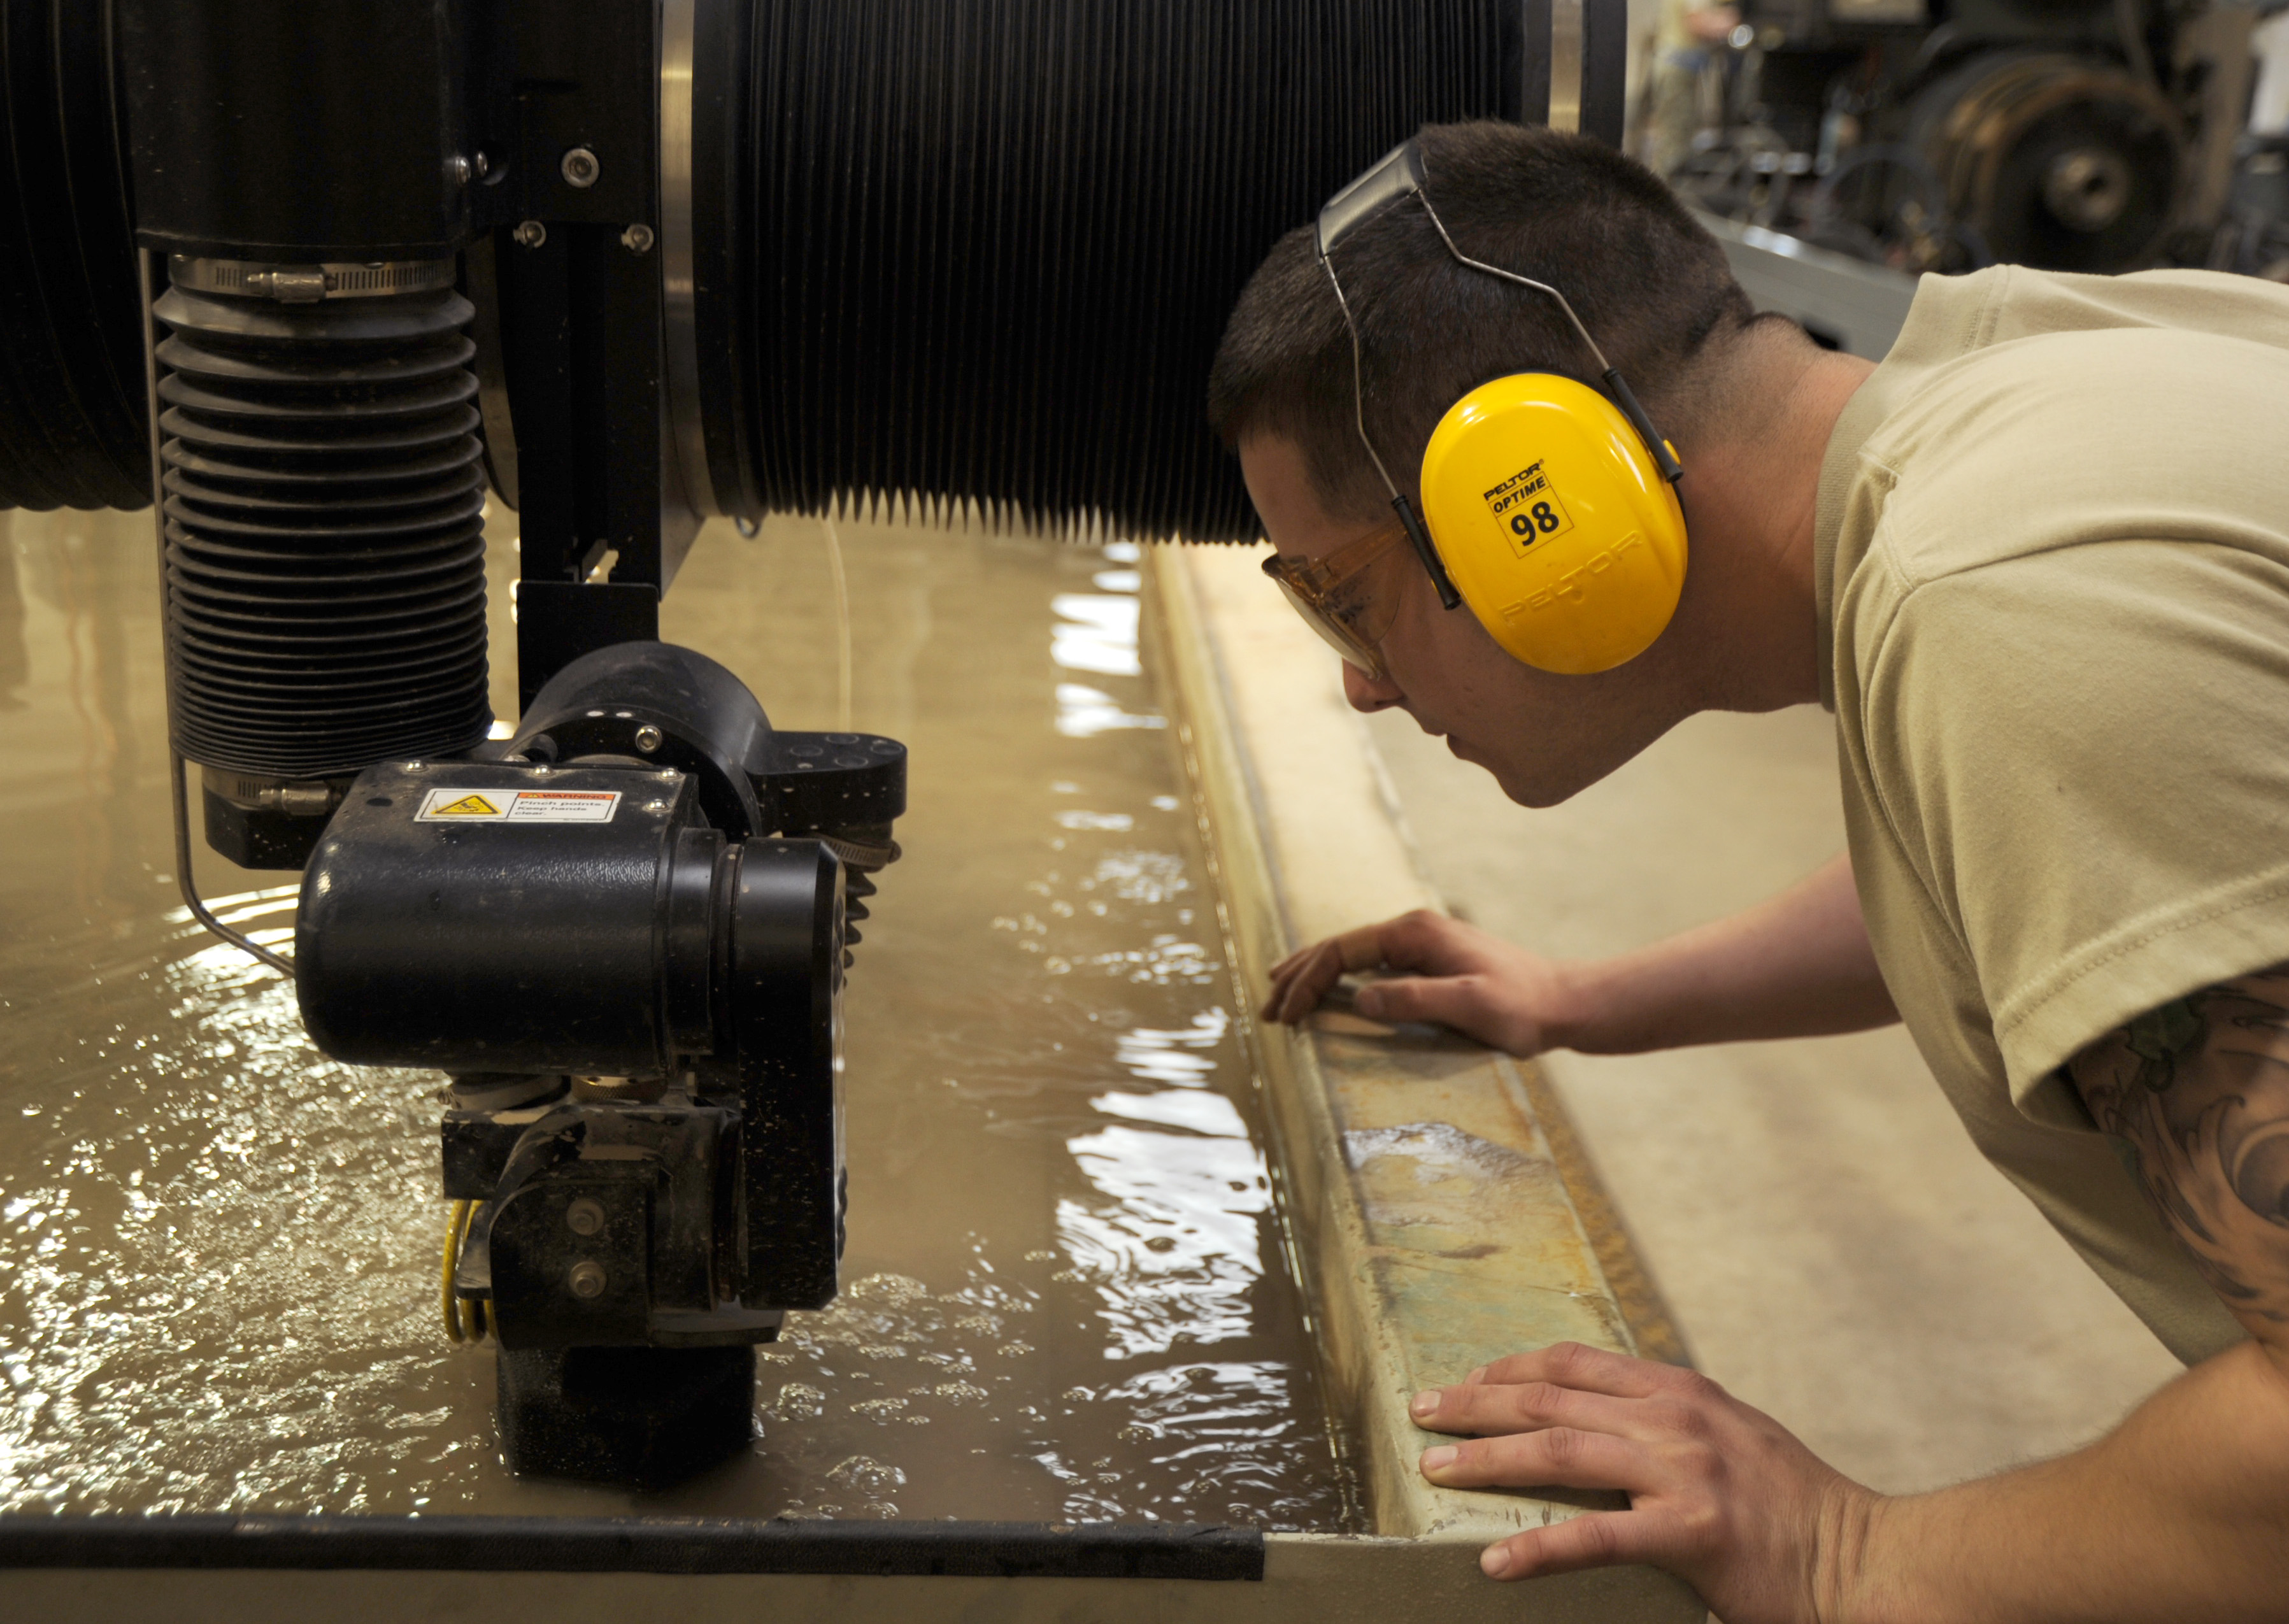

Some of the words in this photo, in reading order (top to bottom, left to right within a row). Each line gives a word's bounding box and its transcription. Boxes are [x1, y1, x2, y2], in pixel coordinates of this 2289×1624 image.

[1494, 476, 1546, 513] OPTIME
[1511, 501, 1559, 546] 98
[1498, 530, 1643, 626] PELTOR
